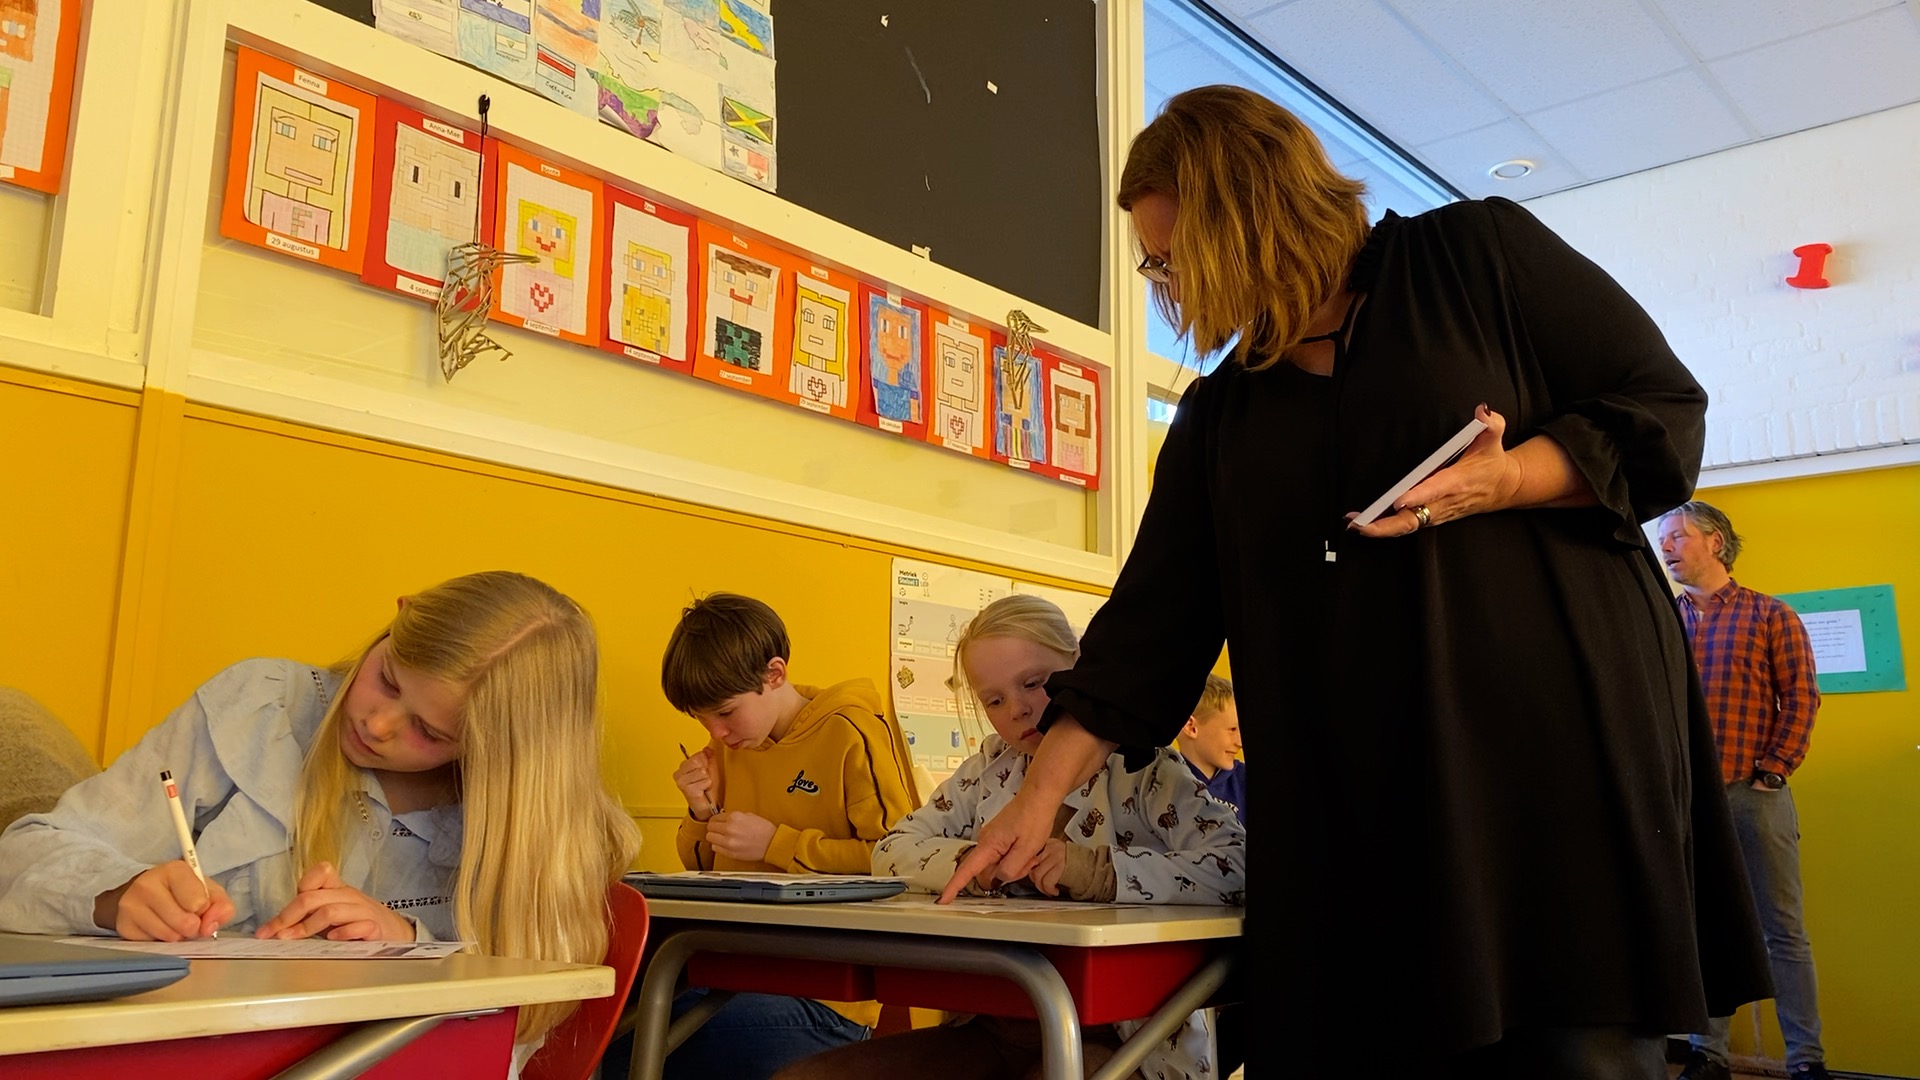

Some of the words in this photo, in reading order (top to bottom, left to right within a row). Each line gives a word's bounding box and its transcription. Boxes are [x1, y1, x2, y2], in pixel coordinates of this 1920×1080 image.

[298, 75, 320, 89] Fenna
[429, 123, 461, 138] Anna-Mae
[271, 237, 281, 245] 29
[282, 242, 315, 255] augustus
[415, 286, 439, 297] septem
[529, 321, 559, 333] september
[633, 350, 659, 362] september
[899, 570, 917, 578] Metriek
